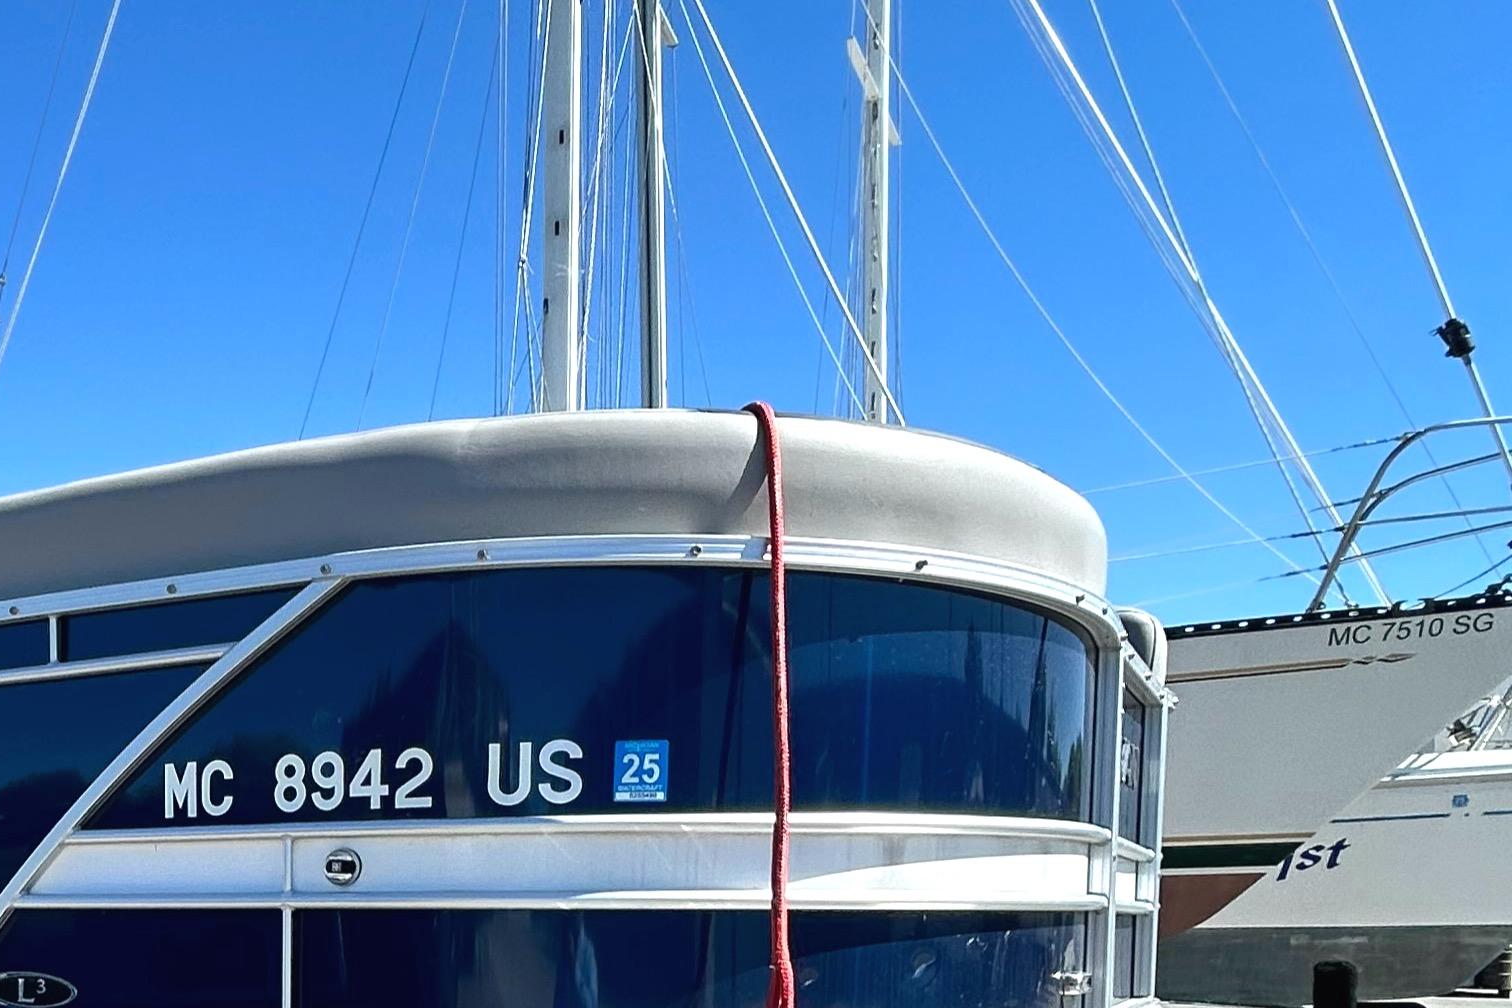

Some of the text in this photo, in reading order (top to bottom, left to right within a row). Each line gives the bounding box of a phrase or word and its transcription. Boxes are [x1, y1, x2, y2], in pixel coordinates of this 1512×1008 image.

[1327, 612, 1495, 647] MC 7510 SG
[164, 738, 584, 819] MC 8942 US
[621, 752, 660, 784] 25
